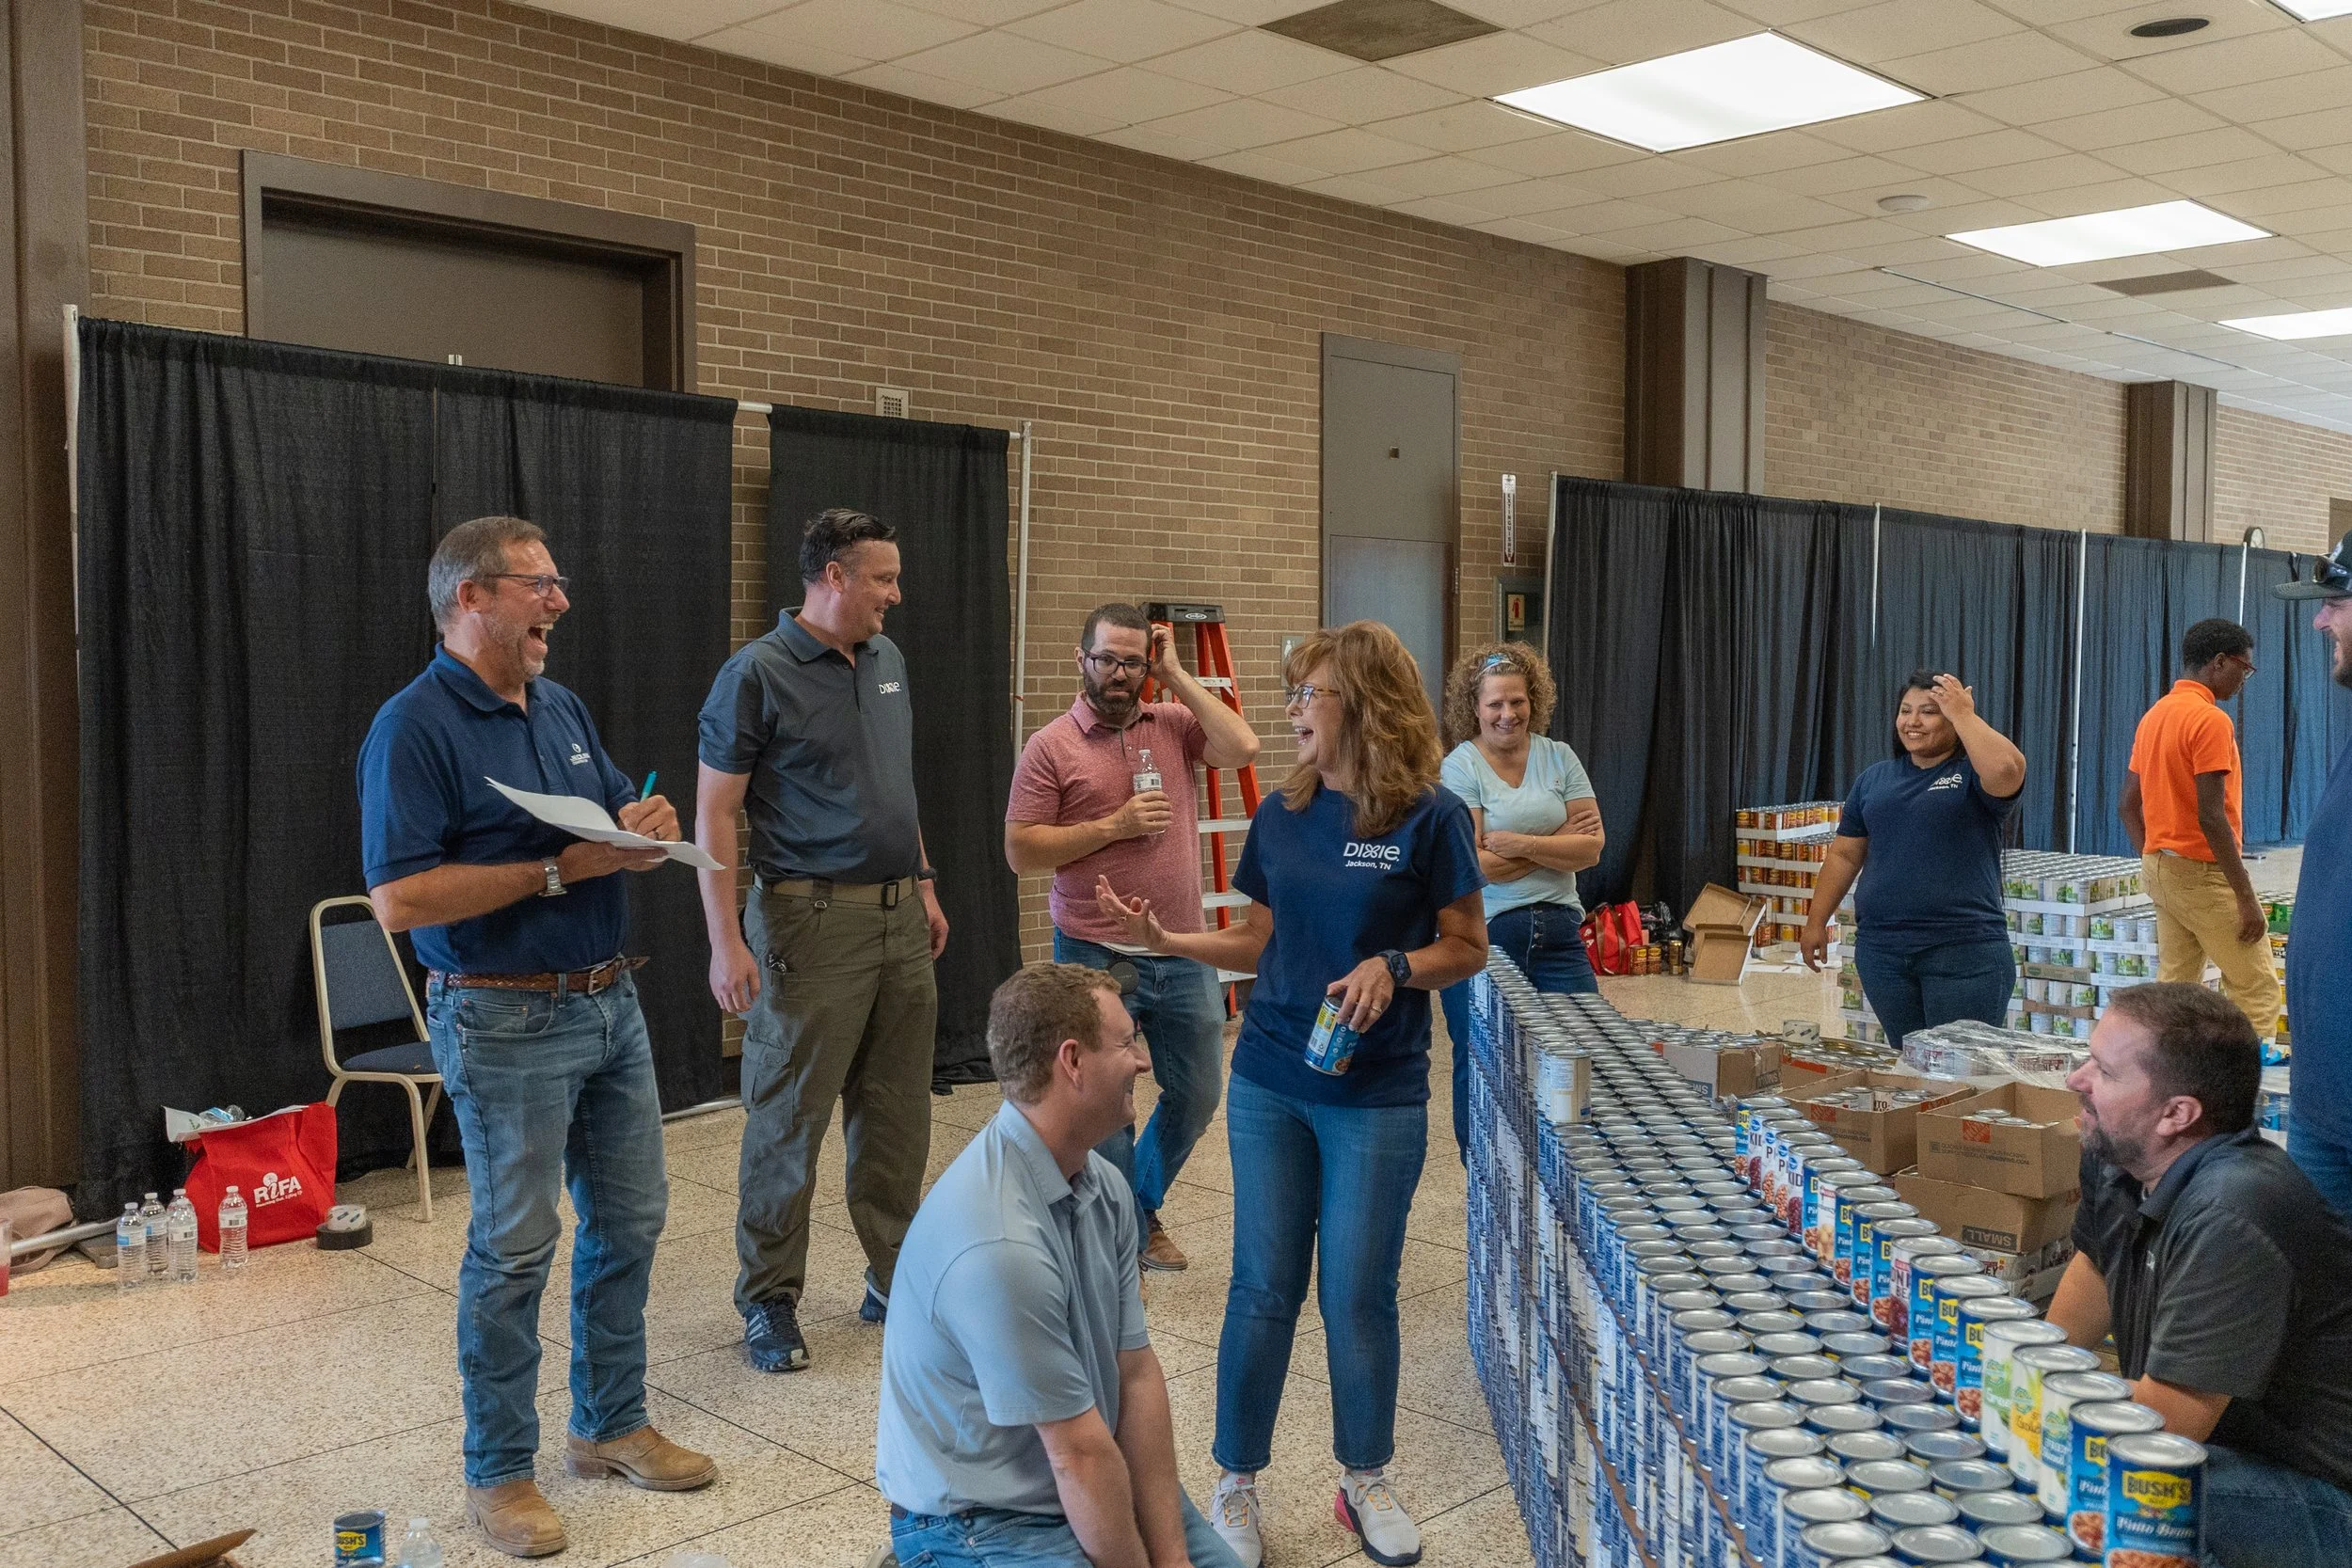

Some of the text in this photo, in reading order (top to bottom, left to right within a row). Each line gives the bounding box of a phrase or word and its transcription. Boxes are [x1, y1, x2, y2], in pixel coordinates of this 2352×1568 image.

[1345, 860, 1391, 871] Jackson, TN
[1967, 1228, 2011, 1247] SMALL
[2127, 1475, 2190, 1501] BUSH'S
[2117, 1515, 2155, 1534] Pinto
